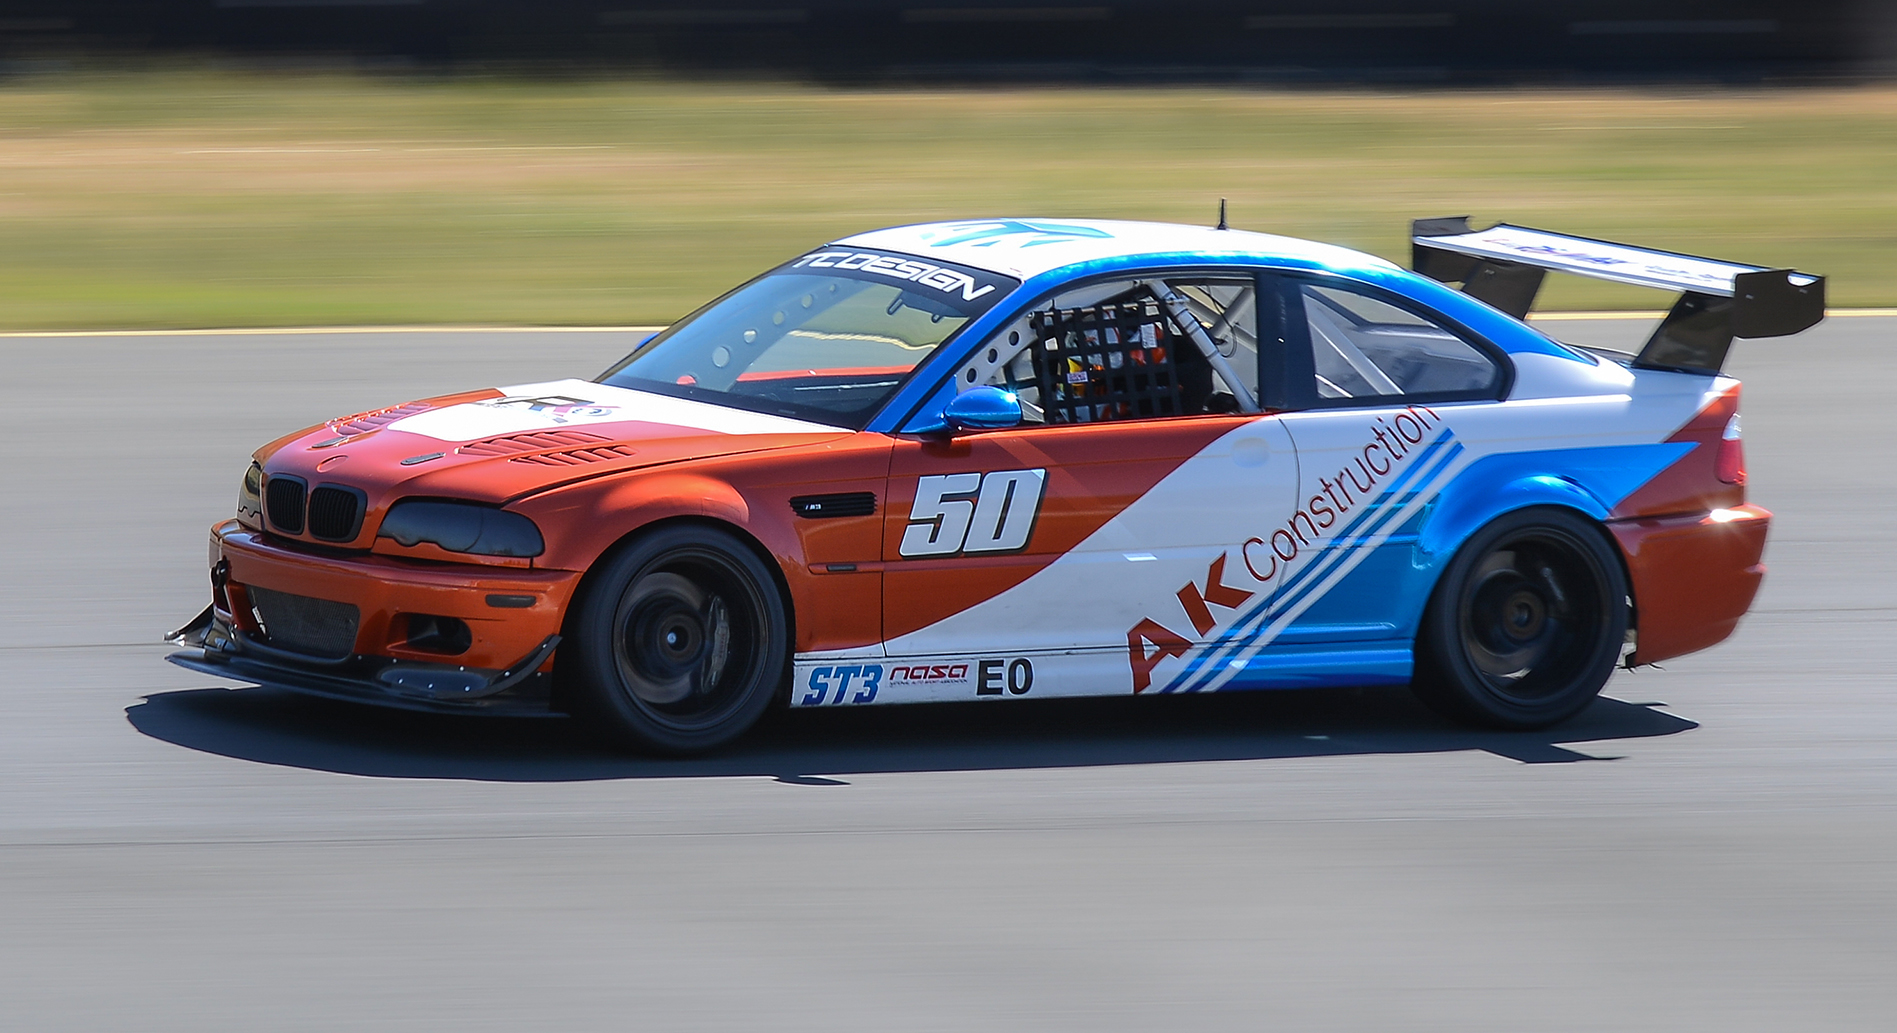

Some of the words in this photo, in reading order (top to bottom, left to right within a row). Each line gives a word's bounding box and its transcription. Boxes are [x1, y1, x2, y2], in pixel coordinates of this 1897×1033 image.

[792, 252, 995, 301] TCDESIGN
[899, 467, 1048, 558] 50
[1127, 551, 1256, 694] AK
[1242, 404, 1442, 582] Construction
[802, 665, 883, 705] ST3
[889, 664, 969, 680] nasa
